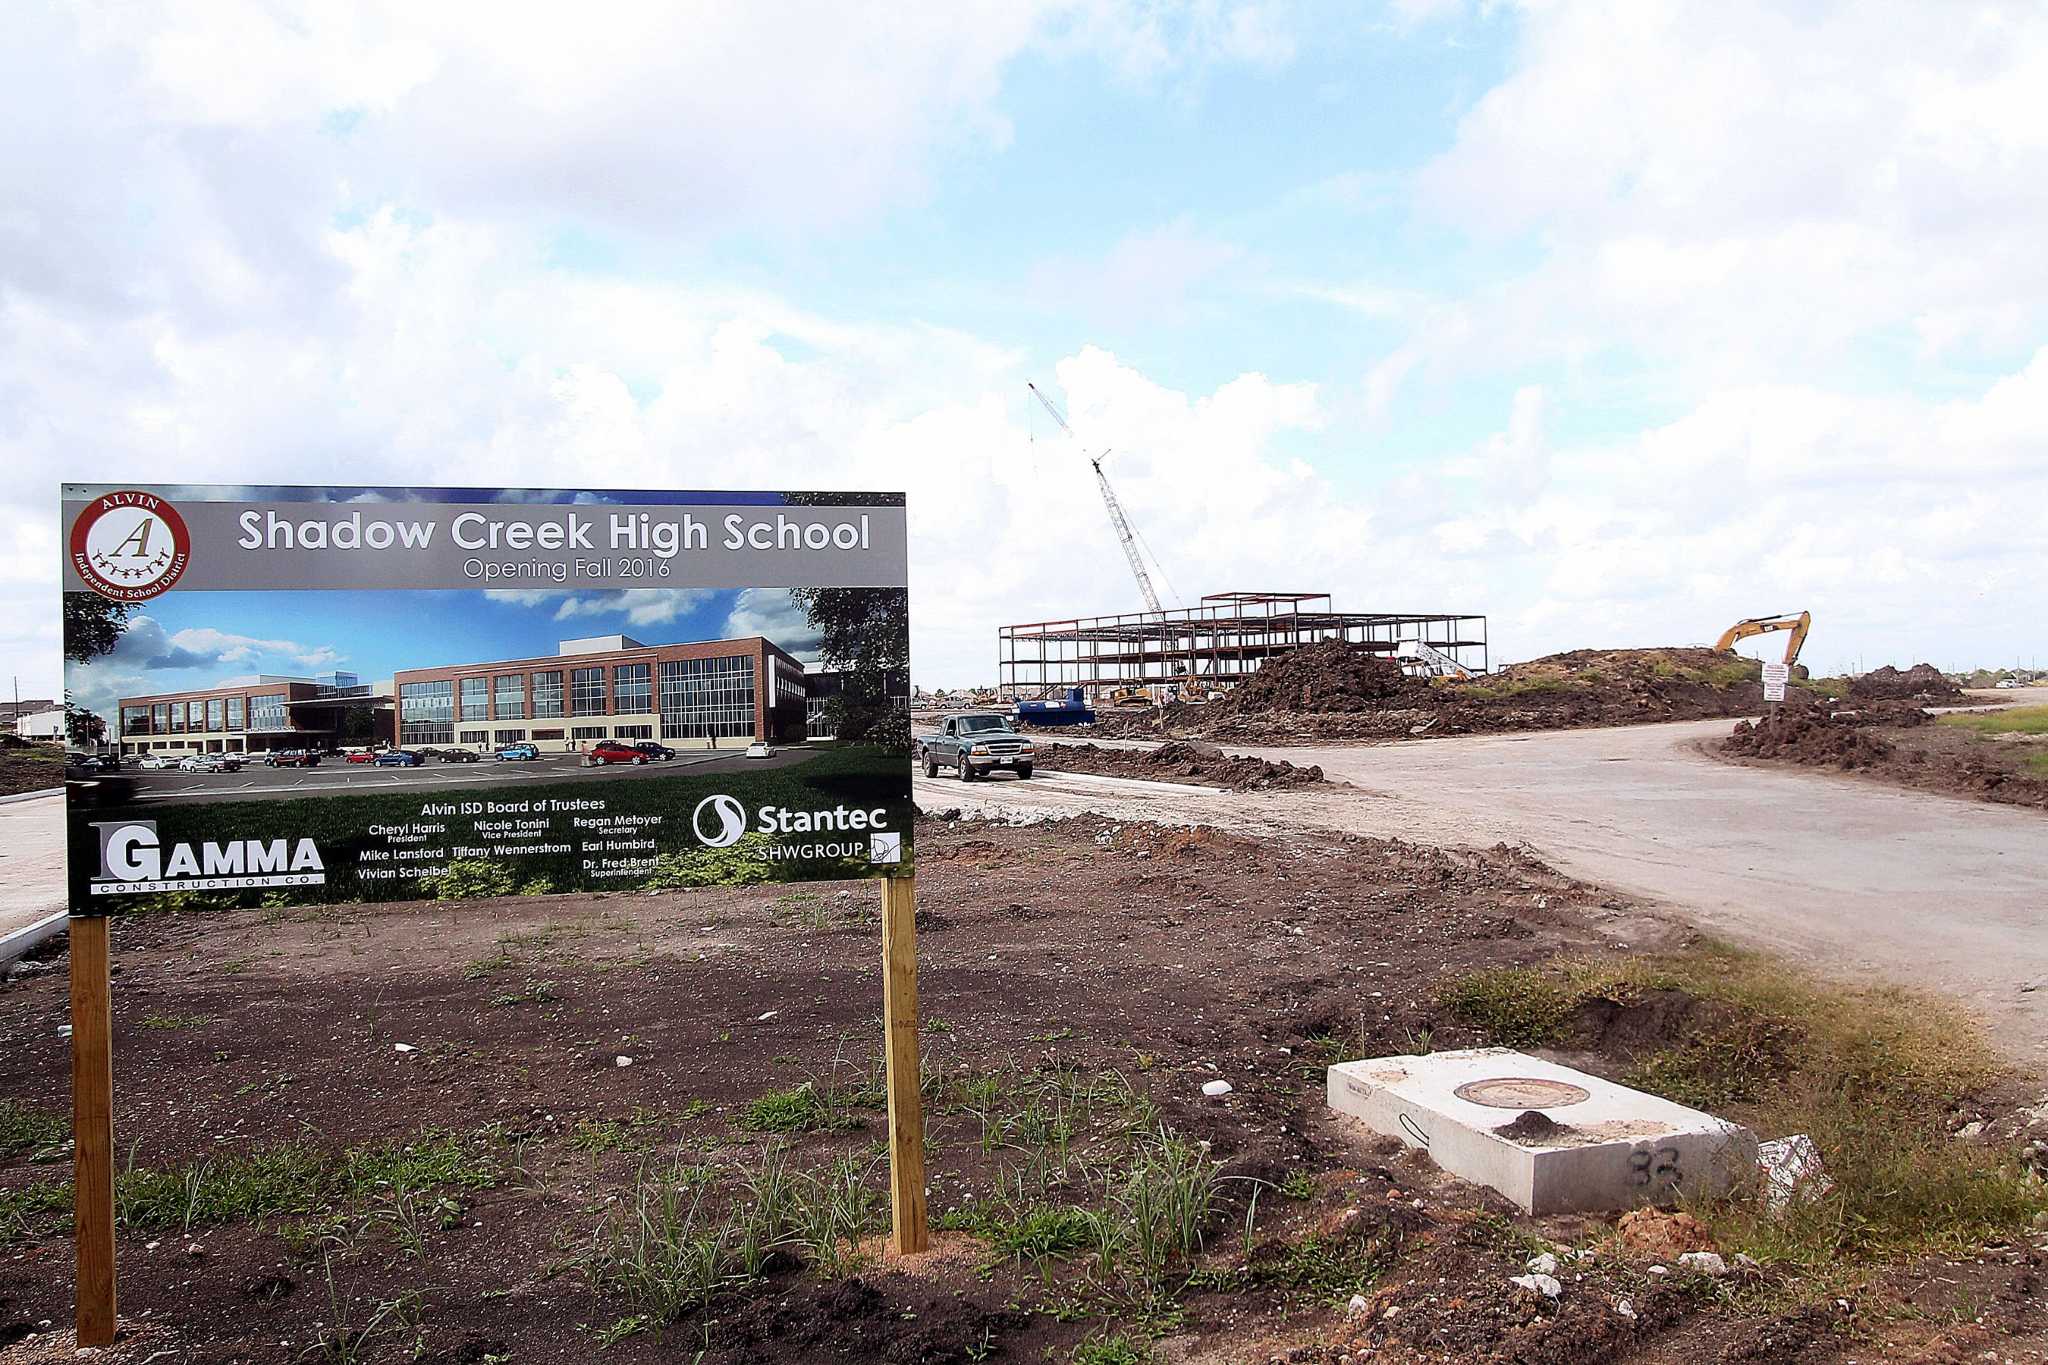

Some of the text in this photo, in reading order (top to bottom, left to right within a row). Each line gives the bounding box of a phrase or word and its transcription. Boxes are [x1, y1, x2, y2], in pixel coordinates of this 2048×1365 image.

[102, 493, 160, 510] ALVIN
[108, 518, 153, 557] A
[238, 510, 870, 559] Shadow Creek High School
[75, 552, 185, 598] Independent School District
[463, 558, 671, 582] Opening Fall 2016
[421, 798, 605, 816] Alvin ISD Board of Trustees
[474, 818, 550, 831] Nicole Tonini
[573, 815, 663, 829] Regan Metoyer
[757, 804, 887, 834] Stantec
[368, 822, 446, 836] Cheryl Harris
[482, 829, 542, 839] Vice President
[598, 826, 638, 835] Secretary
[387, 834, 427, 843] President
[581, 838, 655, 852] Earl Humbird
[106, 824, 325, 881] GAMMA
[359, 847, 444, 861] Mike Lansford
[451, 843, 572, 858] Tiffany Wennerstrom
[758, 842, 864, 861] SHWGROUP
[583, 856, 660, 869] Dr. Fred Brent
[358, 868, 396, 879] Vivian
[590, 868, 652, 878] Superintendent
[100, 874, 319, 893] CONSTRUCTION CO.
